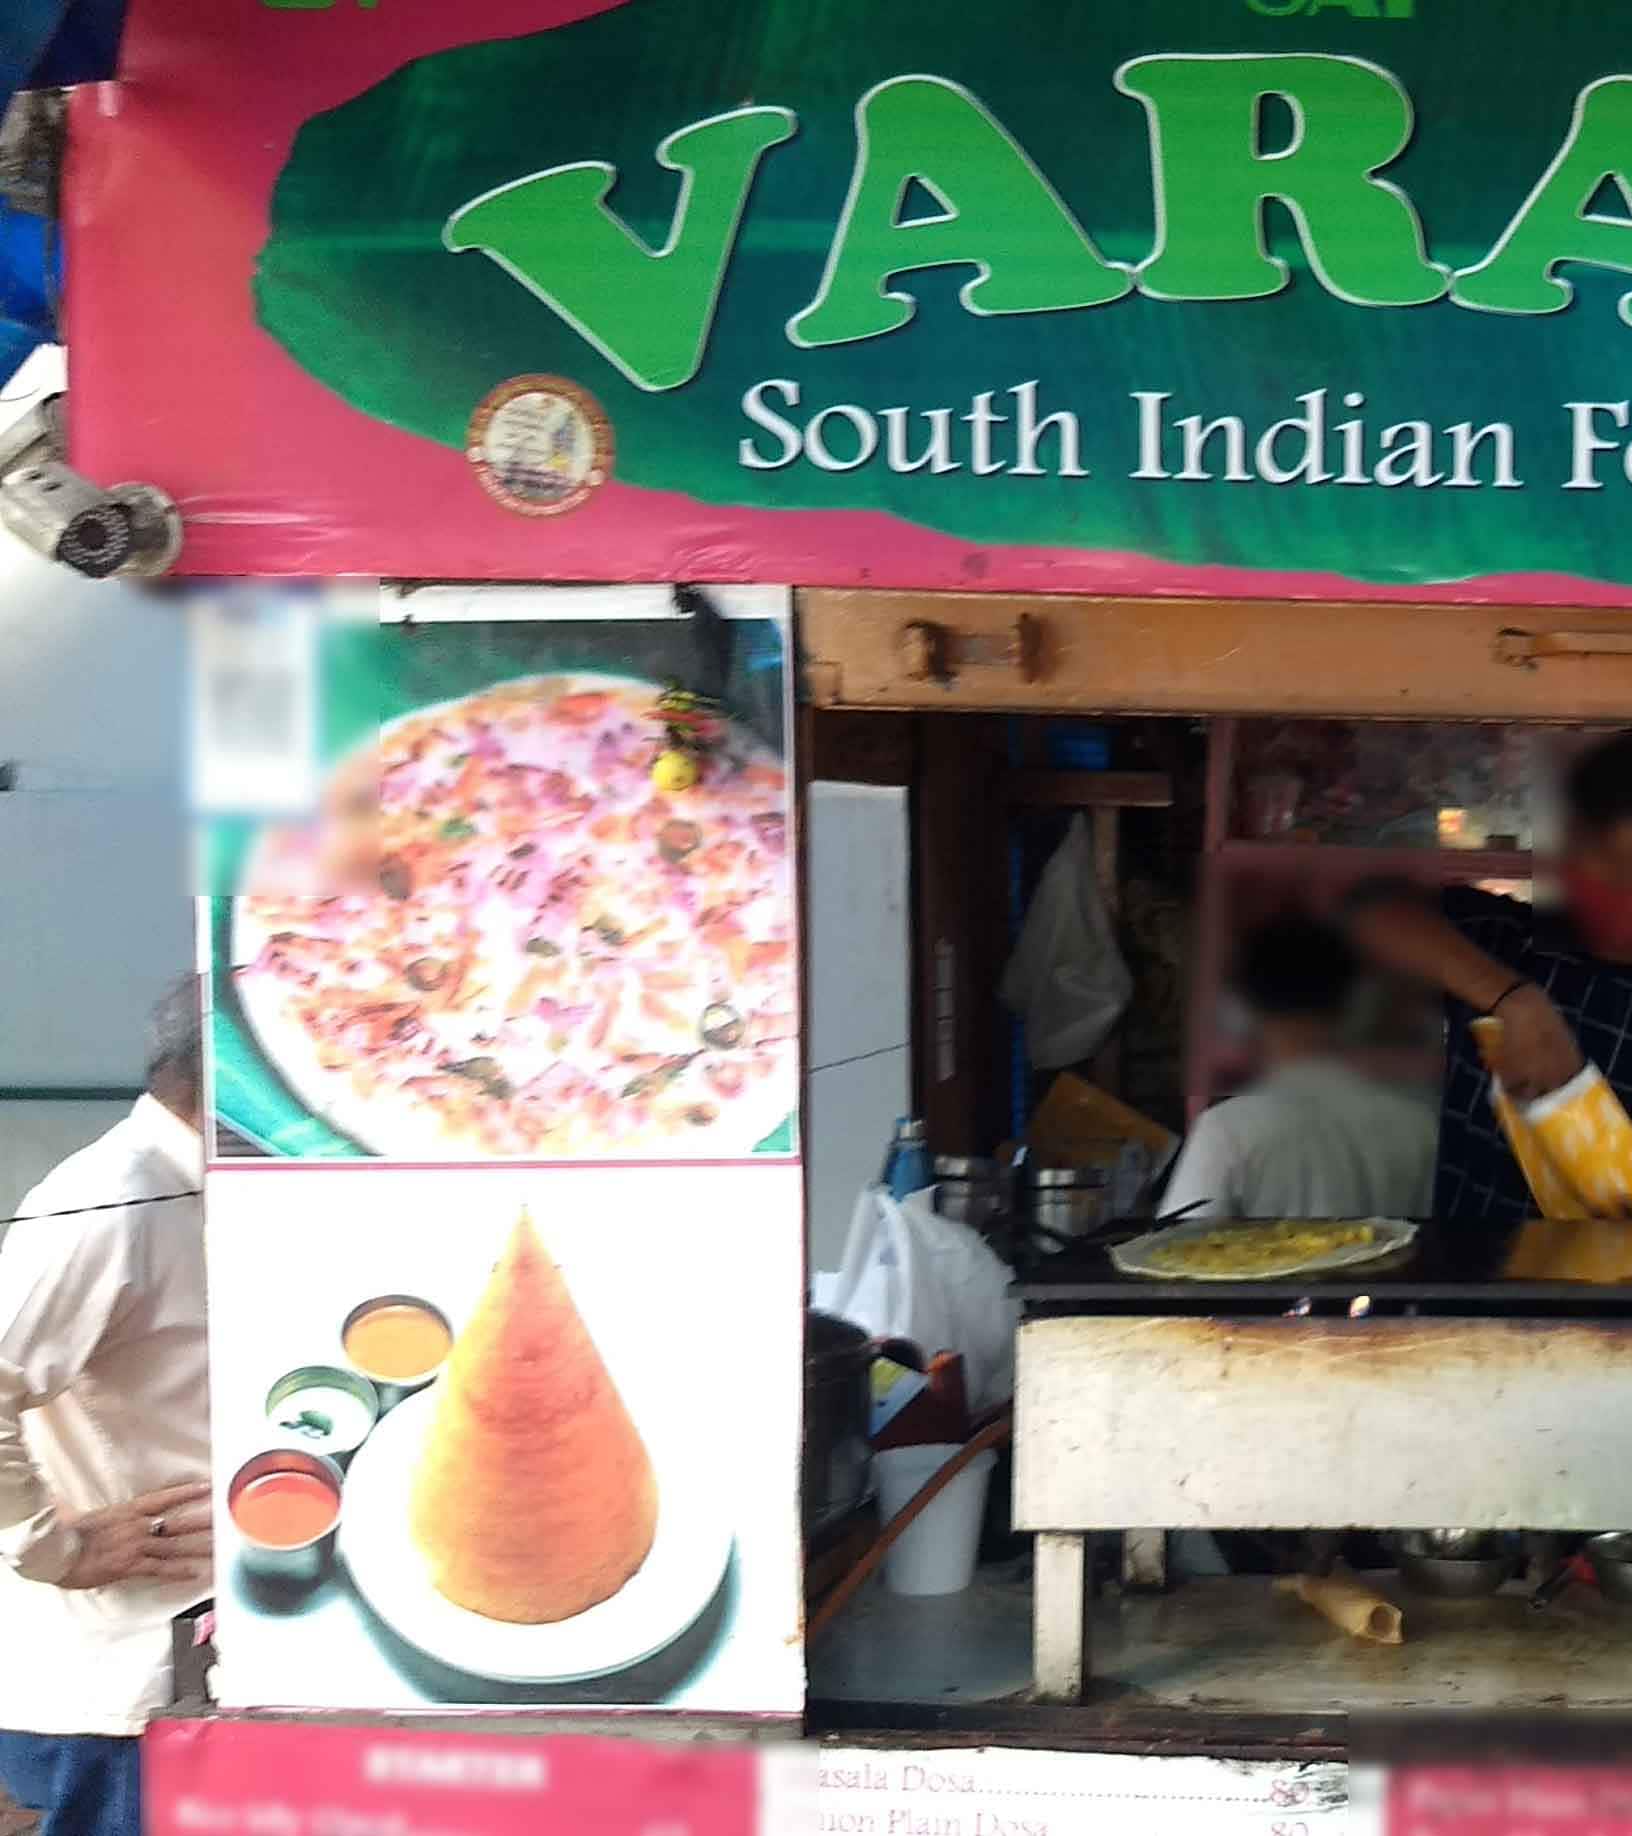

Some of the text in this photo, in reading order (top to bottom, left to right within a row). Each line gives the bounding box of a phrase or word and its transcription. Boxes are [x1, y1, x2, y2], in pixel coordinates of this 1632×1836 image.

[738, 378, 1089, 478] South
[1129, 387, 1522, 491] Indian
[816, 1762, 889, 1791] asala
